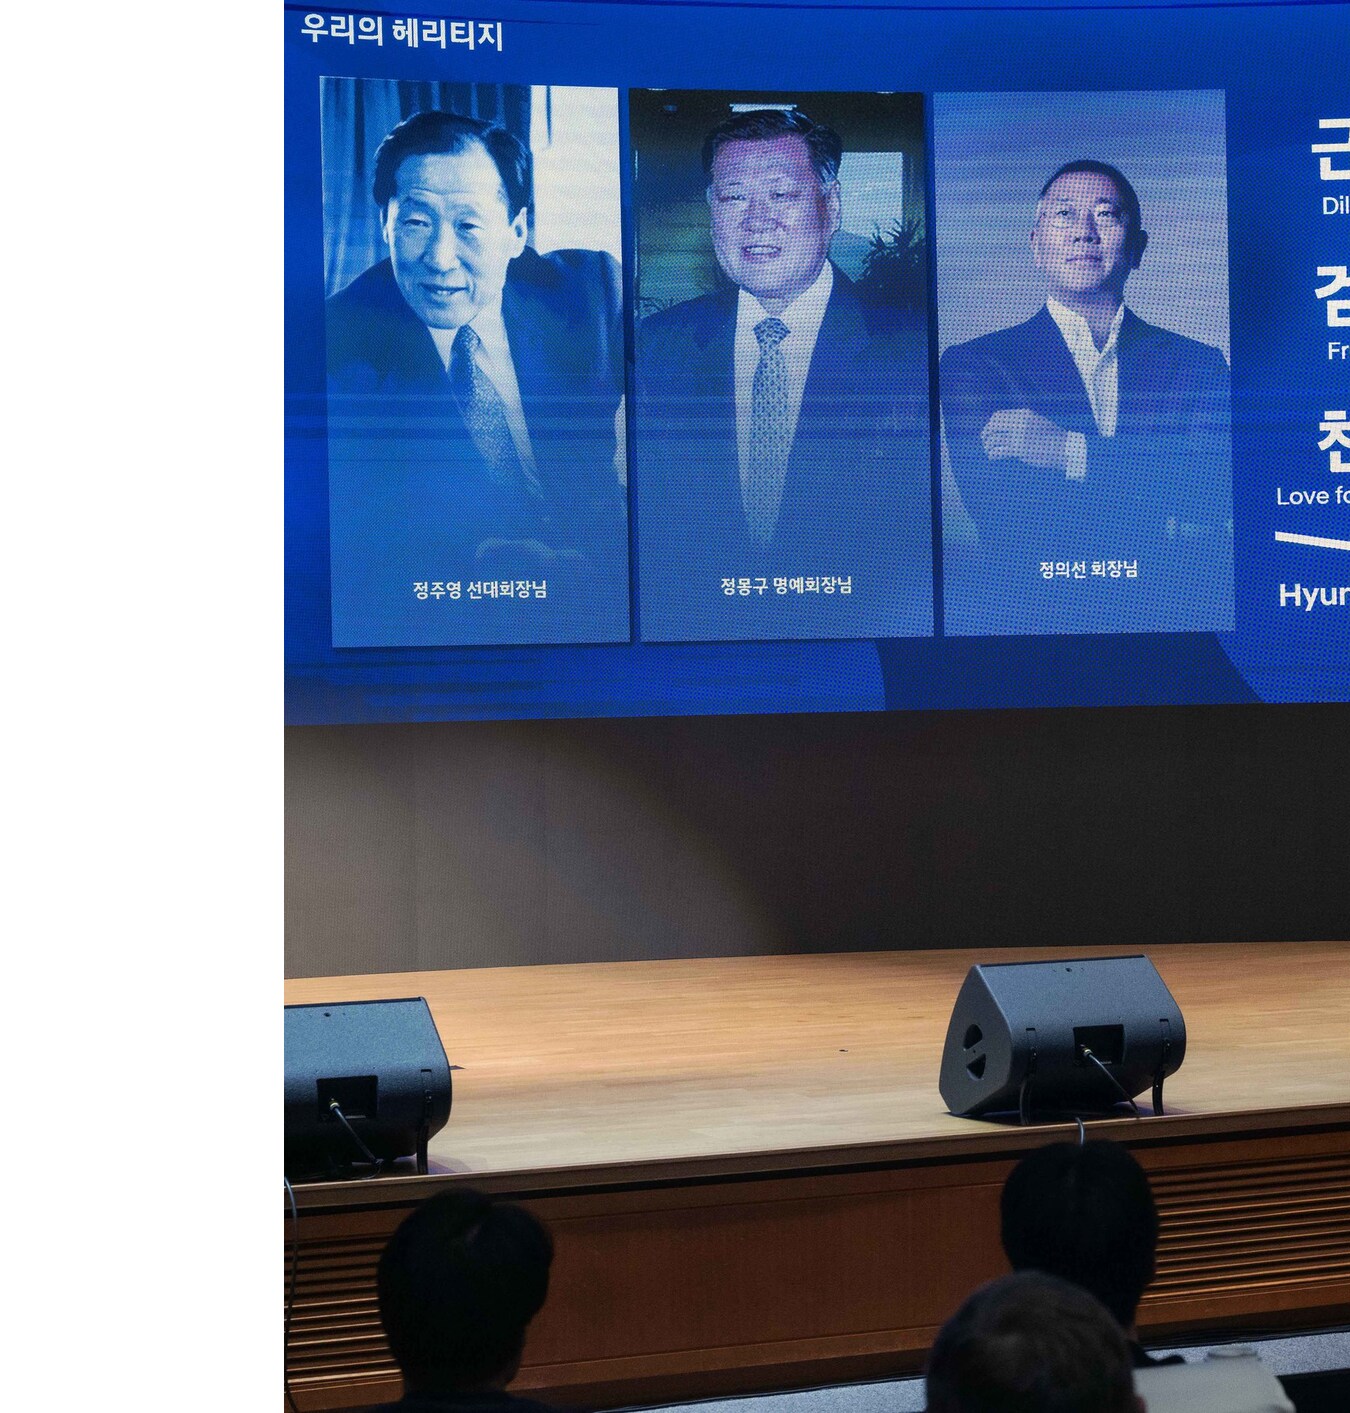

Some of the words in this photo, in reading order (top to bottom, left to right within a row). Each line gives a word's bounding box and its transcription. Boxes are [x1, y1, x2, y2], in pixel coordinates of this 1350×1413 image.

[301, 13, 383, 47] 우리의
[392, 18, 503, 52] 헤리티지
[1276, 487, 1330, 505] Love
[1039, 560, 1087, 579] 정의선
[1091, 559, 1138, 578] 회장님
[413, 580, 461, 600] 정주영
[466, 580, 547, 600] 선대회장님
[721, 577, 769, 596] 정몽구
[773, 576, 852, 595] 명예회장님
